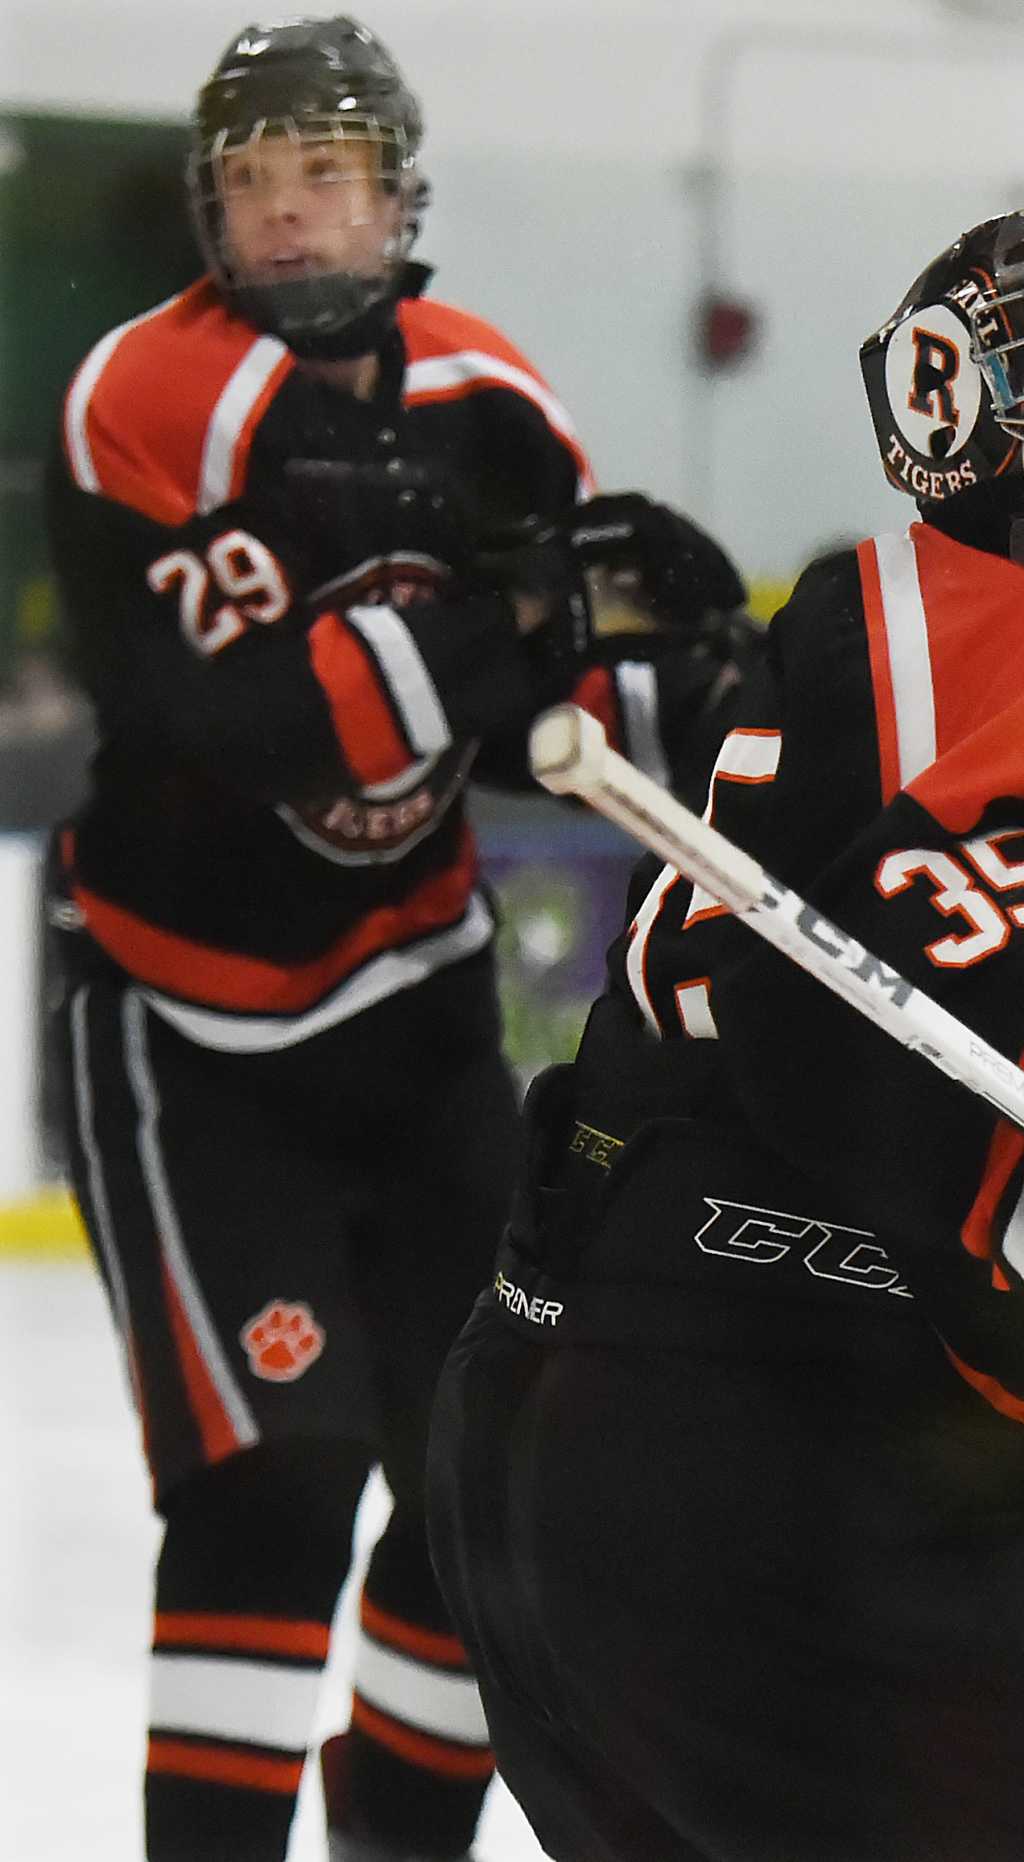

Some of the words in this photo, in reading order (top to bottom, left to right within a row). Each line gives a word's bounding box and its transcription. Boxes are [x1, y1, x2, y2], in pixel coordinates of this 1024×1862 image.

[908, 326, 960, 427] R
[886, 434, 977, 499] TIGERS
[146, 527, 292, 657] 29
[694, 1197, 915, 1298] CC
